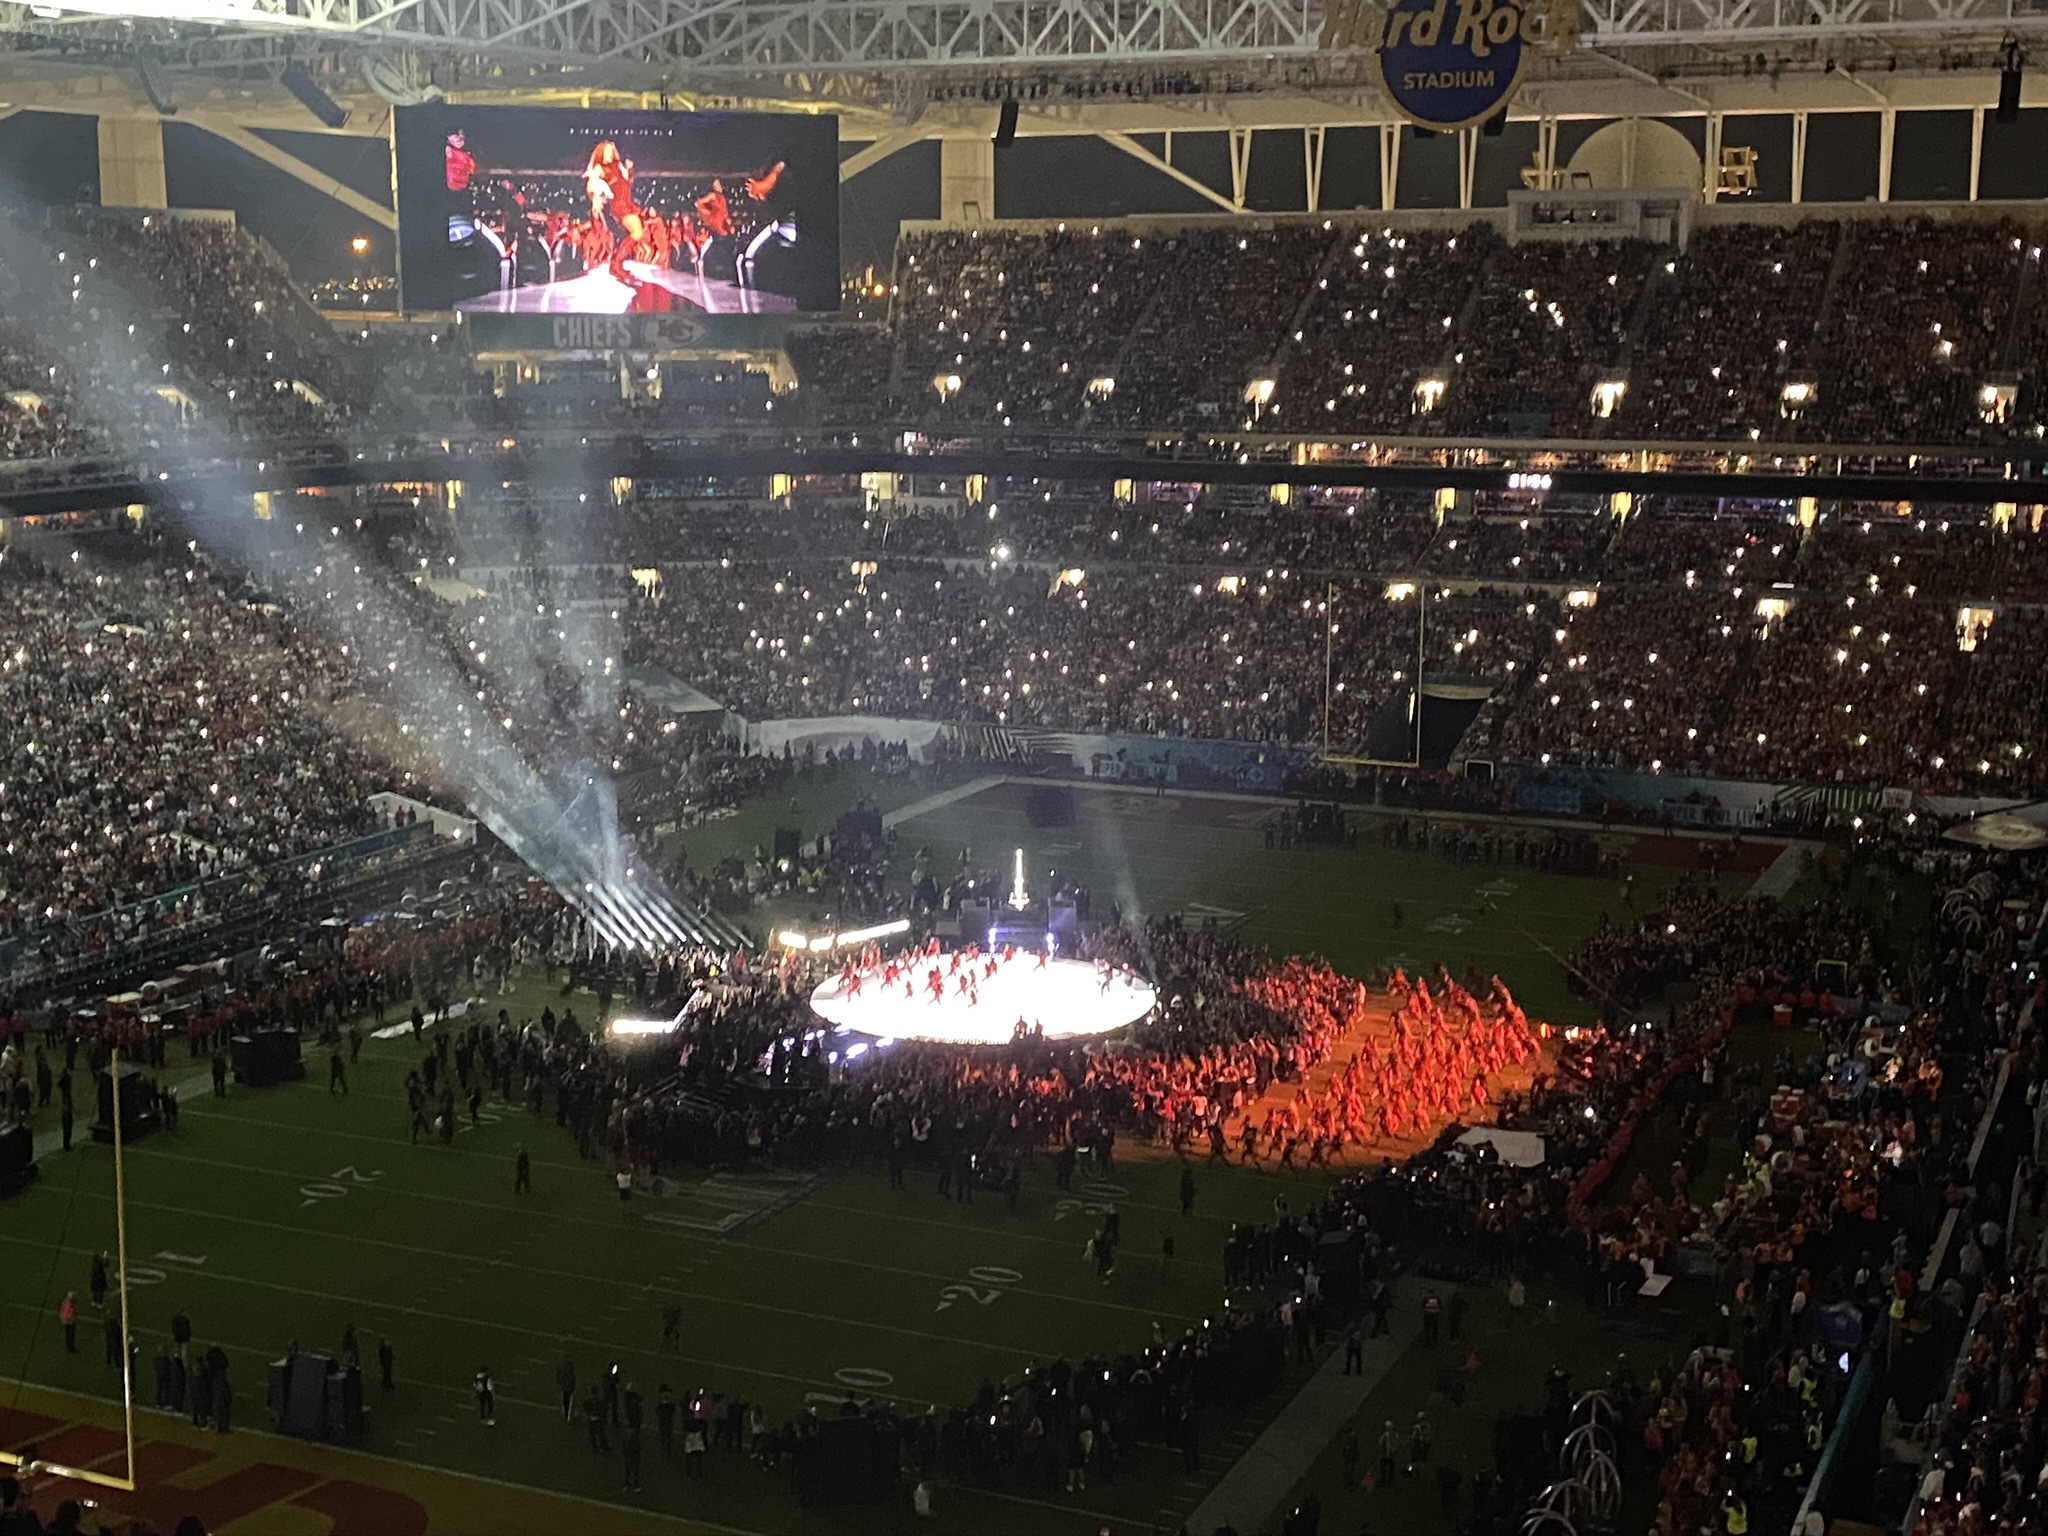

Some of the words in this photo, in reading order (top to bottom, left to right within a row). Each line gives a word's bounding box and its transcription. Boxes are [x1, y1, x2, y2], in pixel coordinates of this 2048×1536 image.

[1318, 0, 1446, 49] Hard
[1452, 0, 1580, 57] Rock
[1403, 71, 1495, 90] STADIUM
[553, 316, 631, 348] CHIEFS
[938, 1265, 1023, 1306] 20
